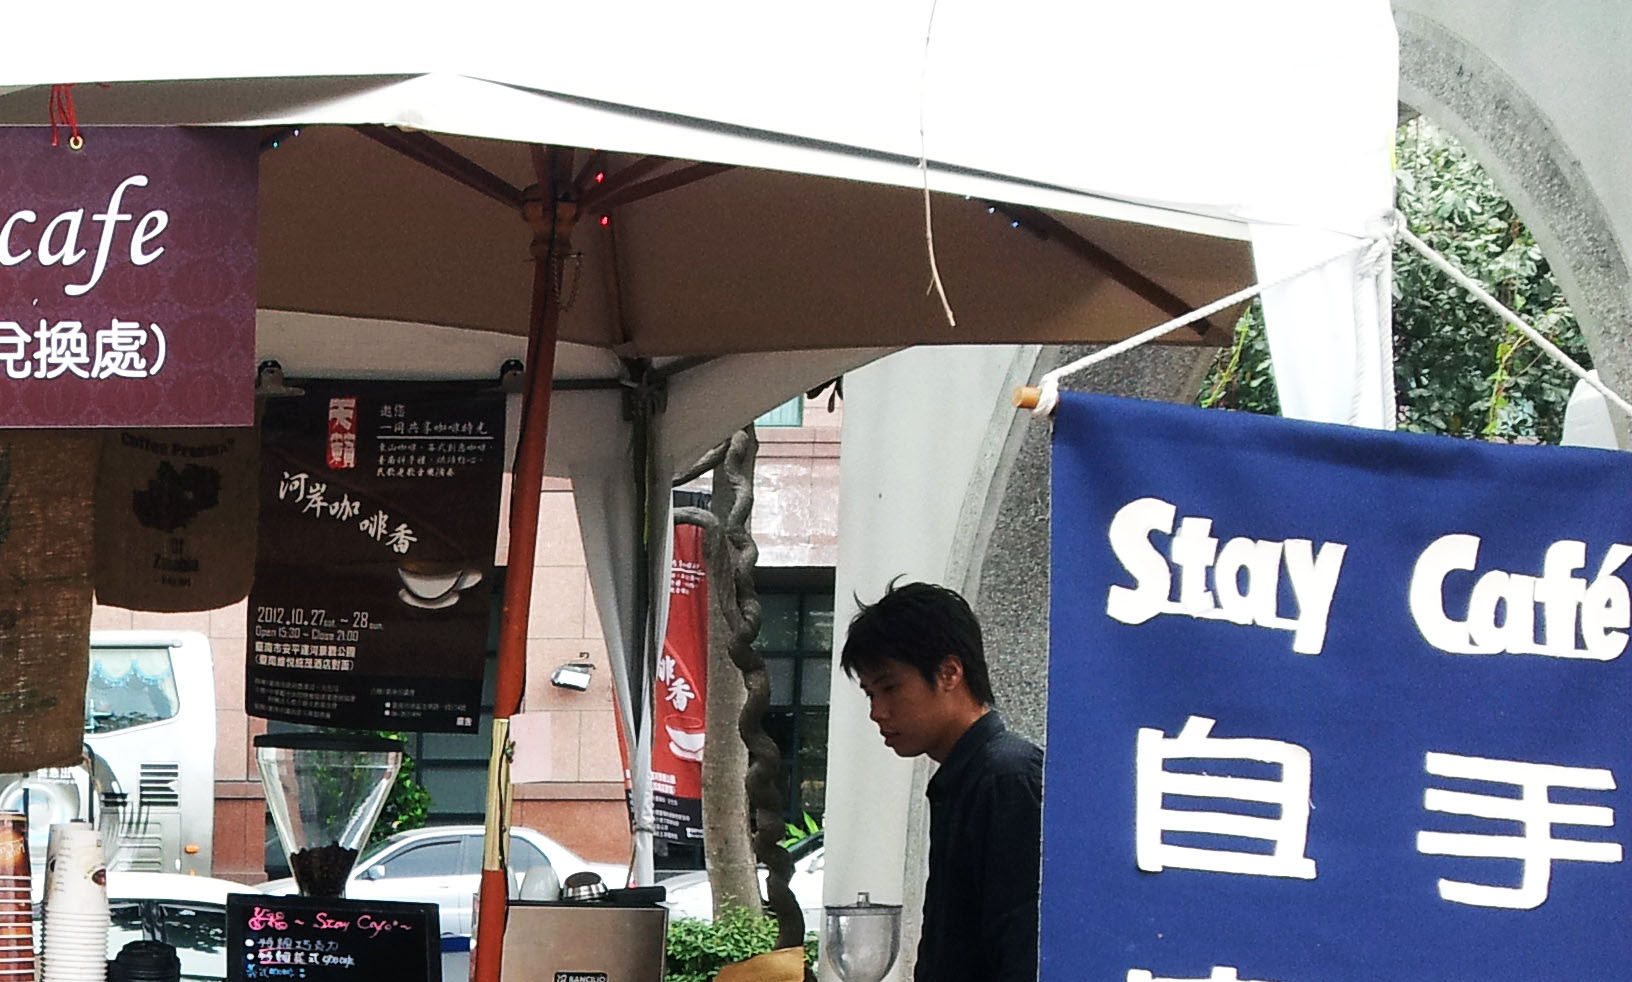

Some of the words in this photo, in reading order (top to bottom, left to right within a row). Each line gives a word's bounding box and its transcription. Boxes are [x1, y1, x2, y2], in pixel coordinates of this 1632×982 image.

[279, 471, 418, 555] 河岸咖啡香
[1107, 497, 1348, 655] Stay
[1410, 534, 1632, 661] Café
